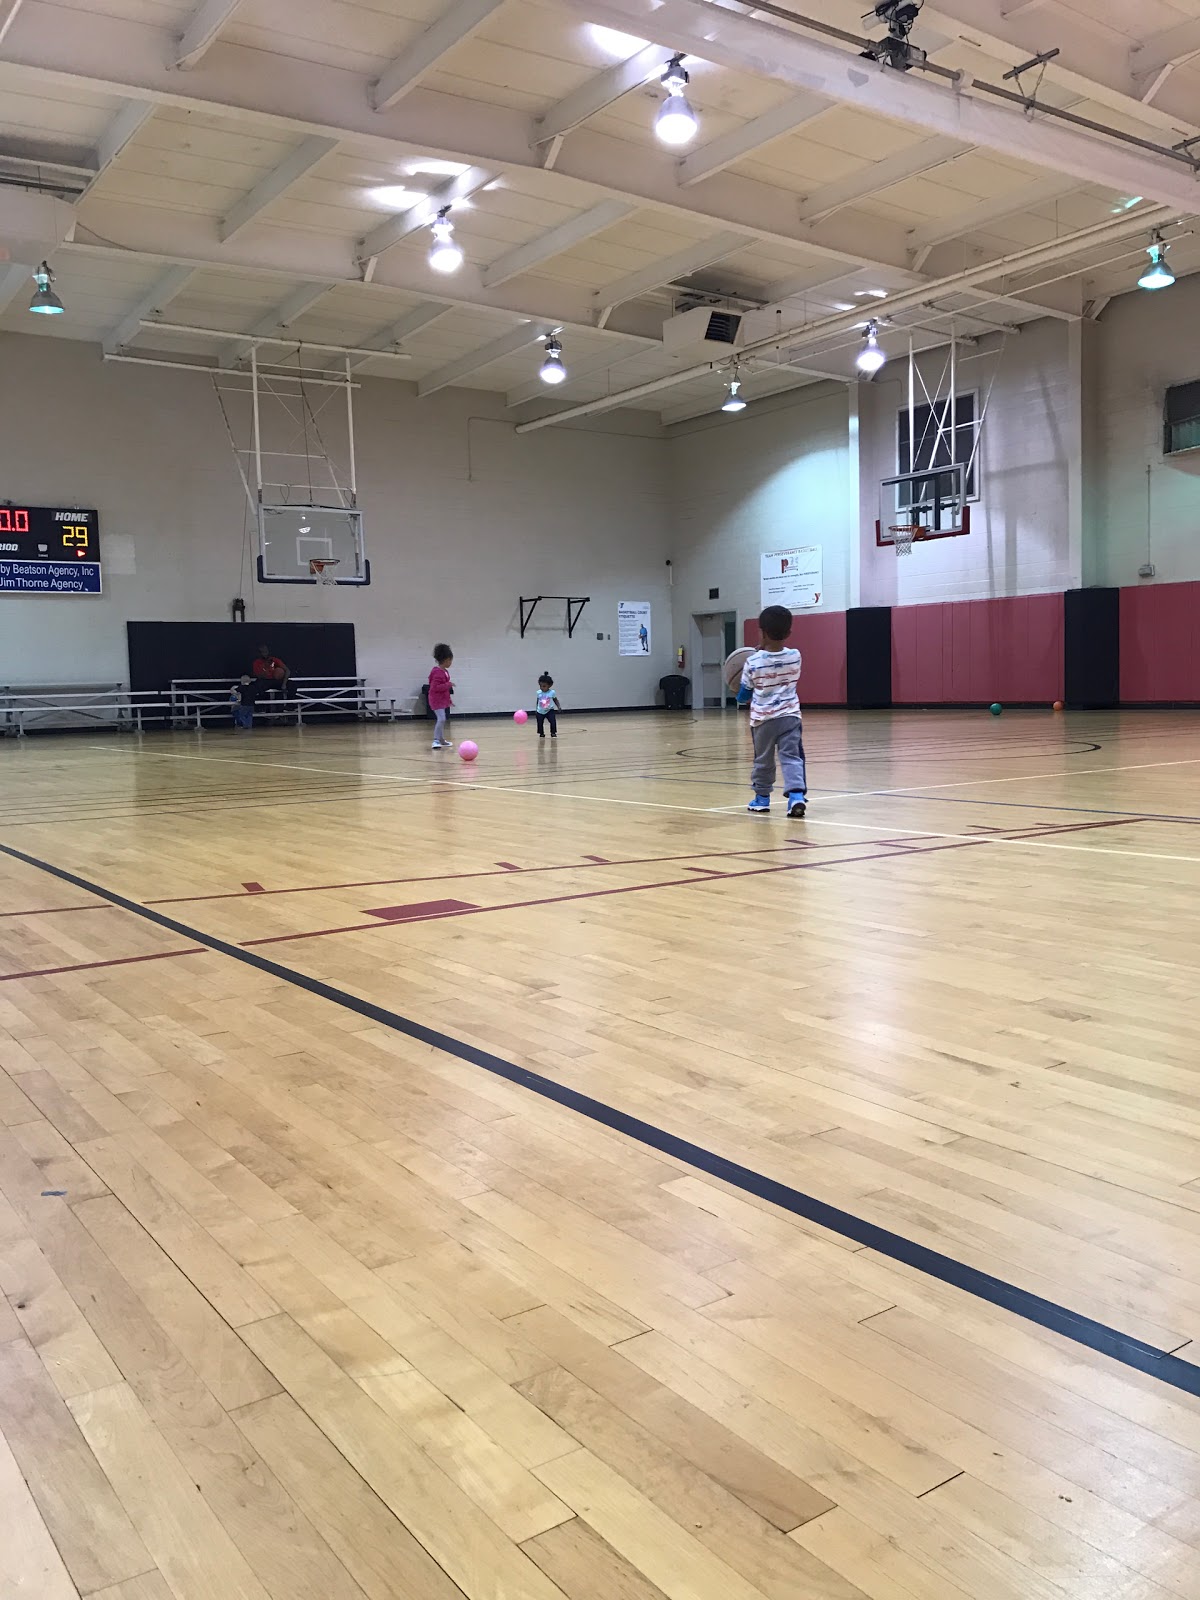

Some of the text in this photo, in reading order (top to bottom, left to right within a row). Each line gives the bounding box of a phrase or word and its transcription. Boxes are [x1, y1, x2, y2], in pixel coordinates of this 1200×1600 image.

[55, 512, 89, 522] HOME
[62, 525, 89, 547] 29
[0, 564, 95, 578] by Beatson Agency, Inc
[15, 577, 49, 588] Thorne
[50, 578, 84, 591] Agency
